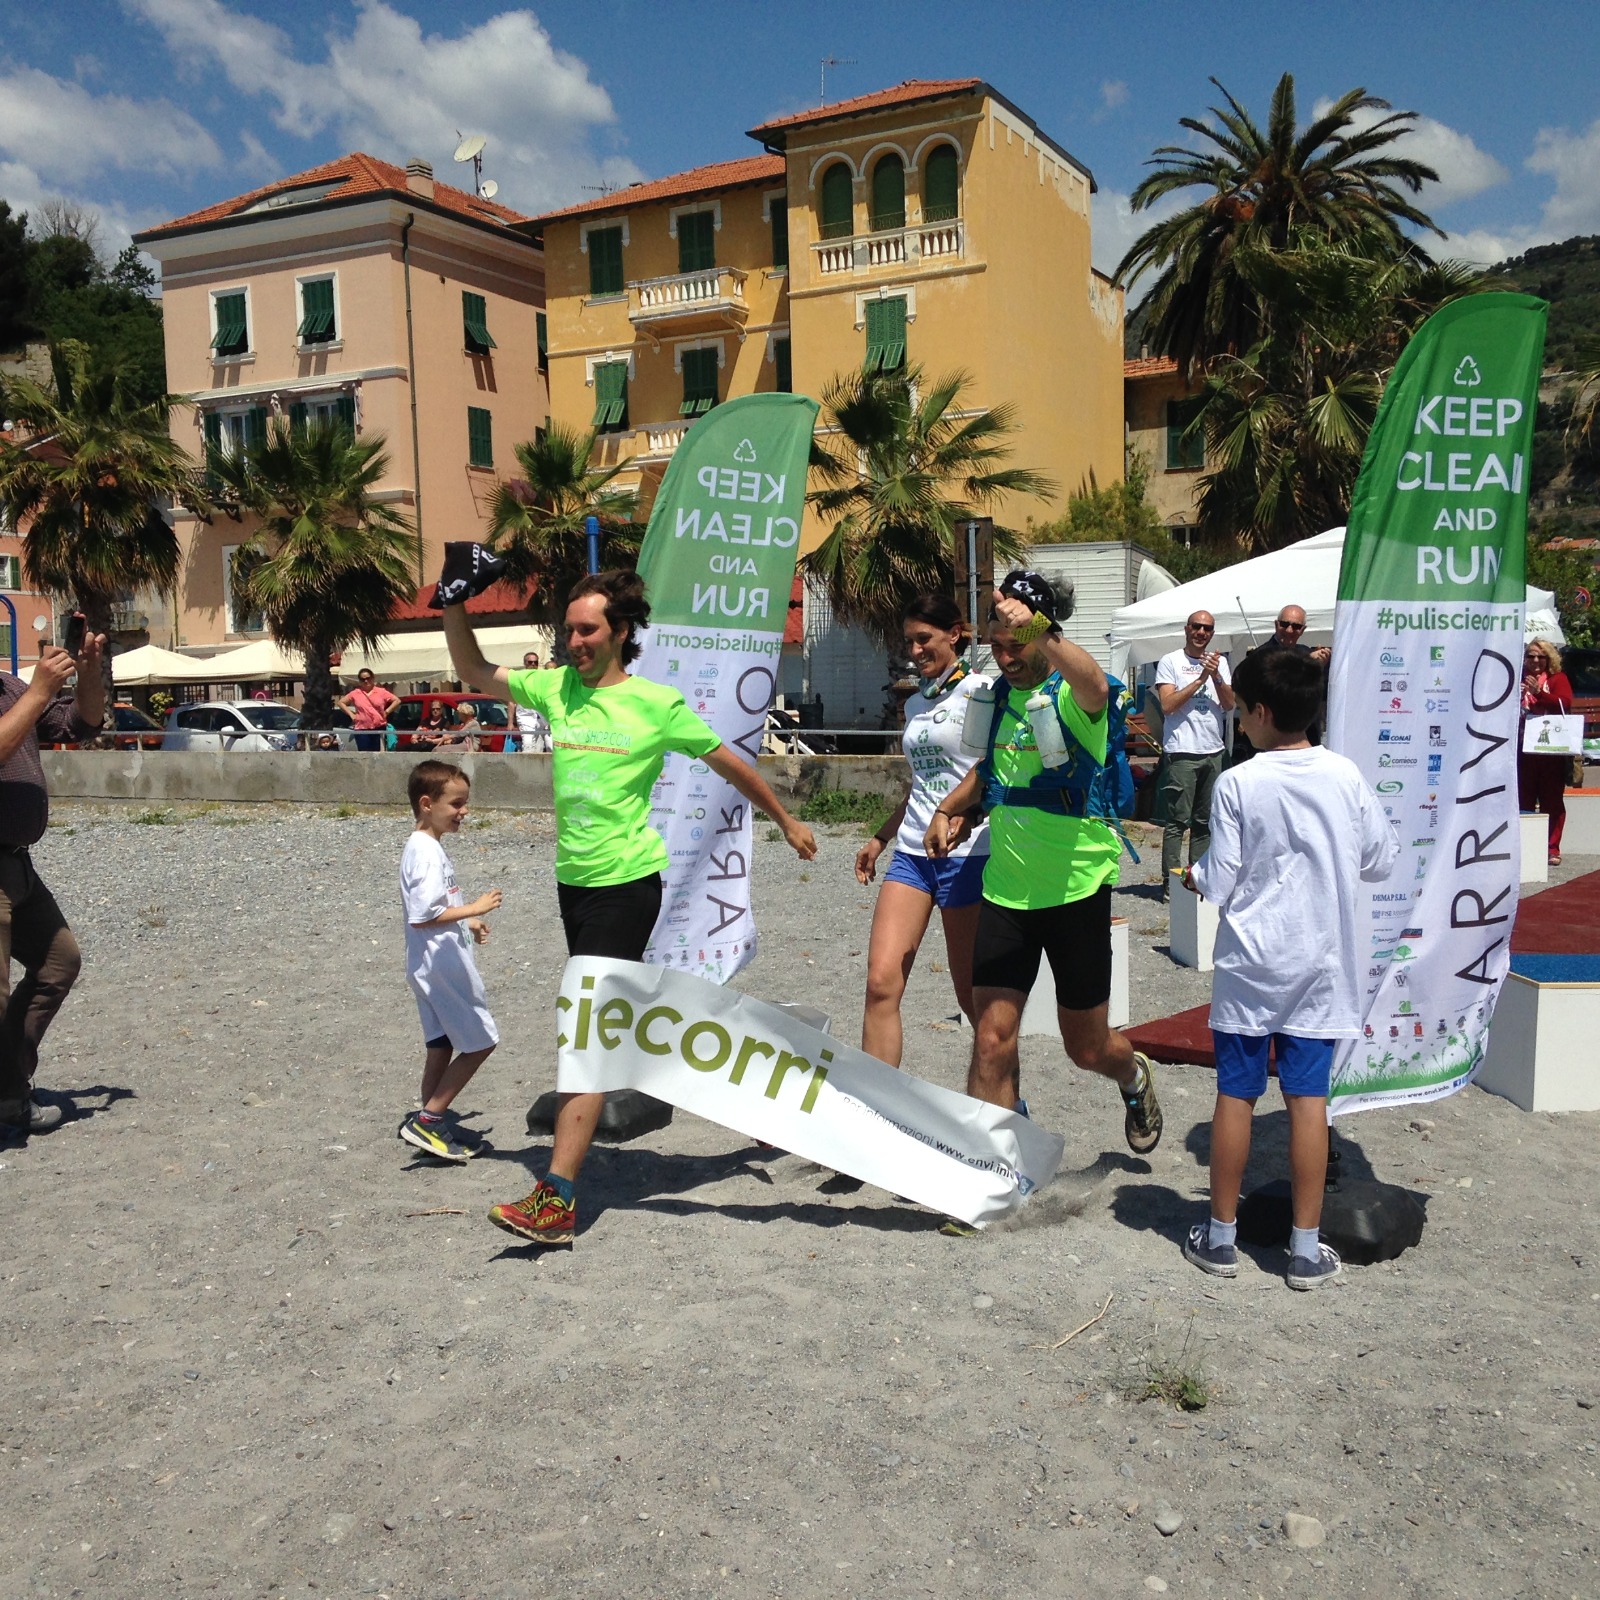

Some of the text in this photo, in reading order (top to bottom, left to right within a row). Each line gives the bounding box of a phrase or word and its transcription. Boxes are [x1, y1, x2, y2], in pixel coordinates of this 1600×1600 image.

[1414, 395, 1522, 437] KEEP
[1433, 508, 1497, 531] AND
[910, 745, 943, 758] KEEP
[913, 757, 955, 771] CLEAN
[925, 770, 940, 779] AND
[920, 780, 949, 793] RUN
[1450, 648, 1515, 986] ARRIVO
